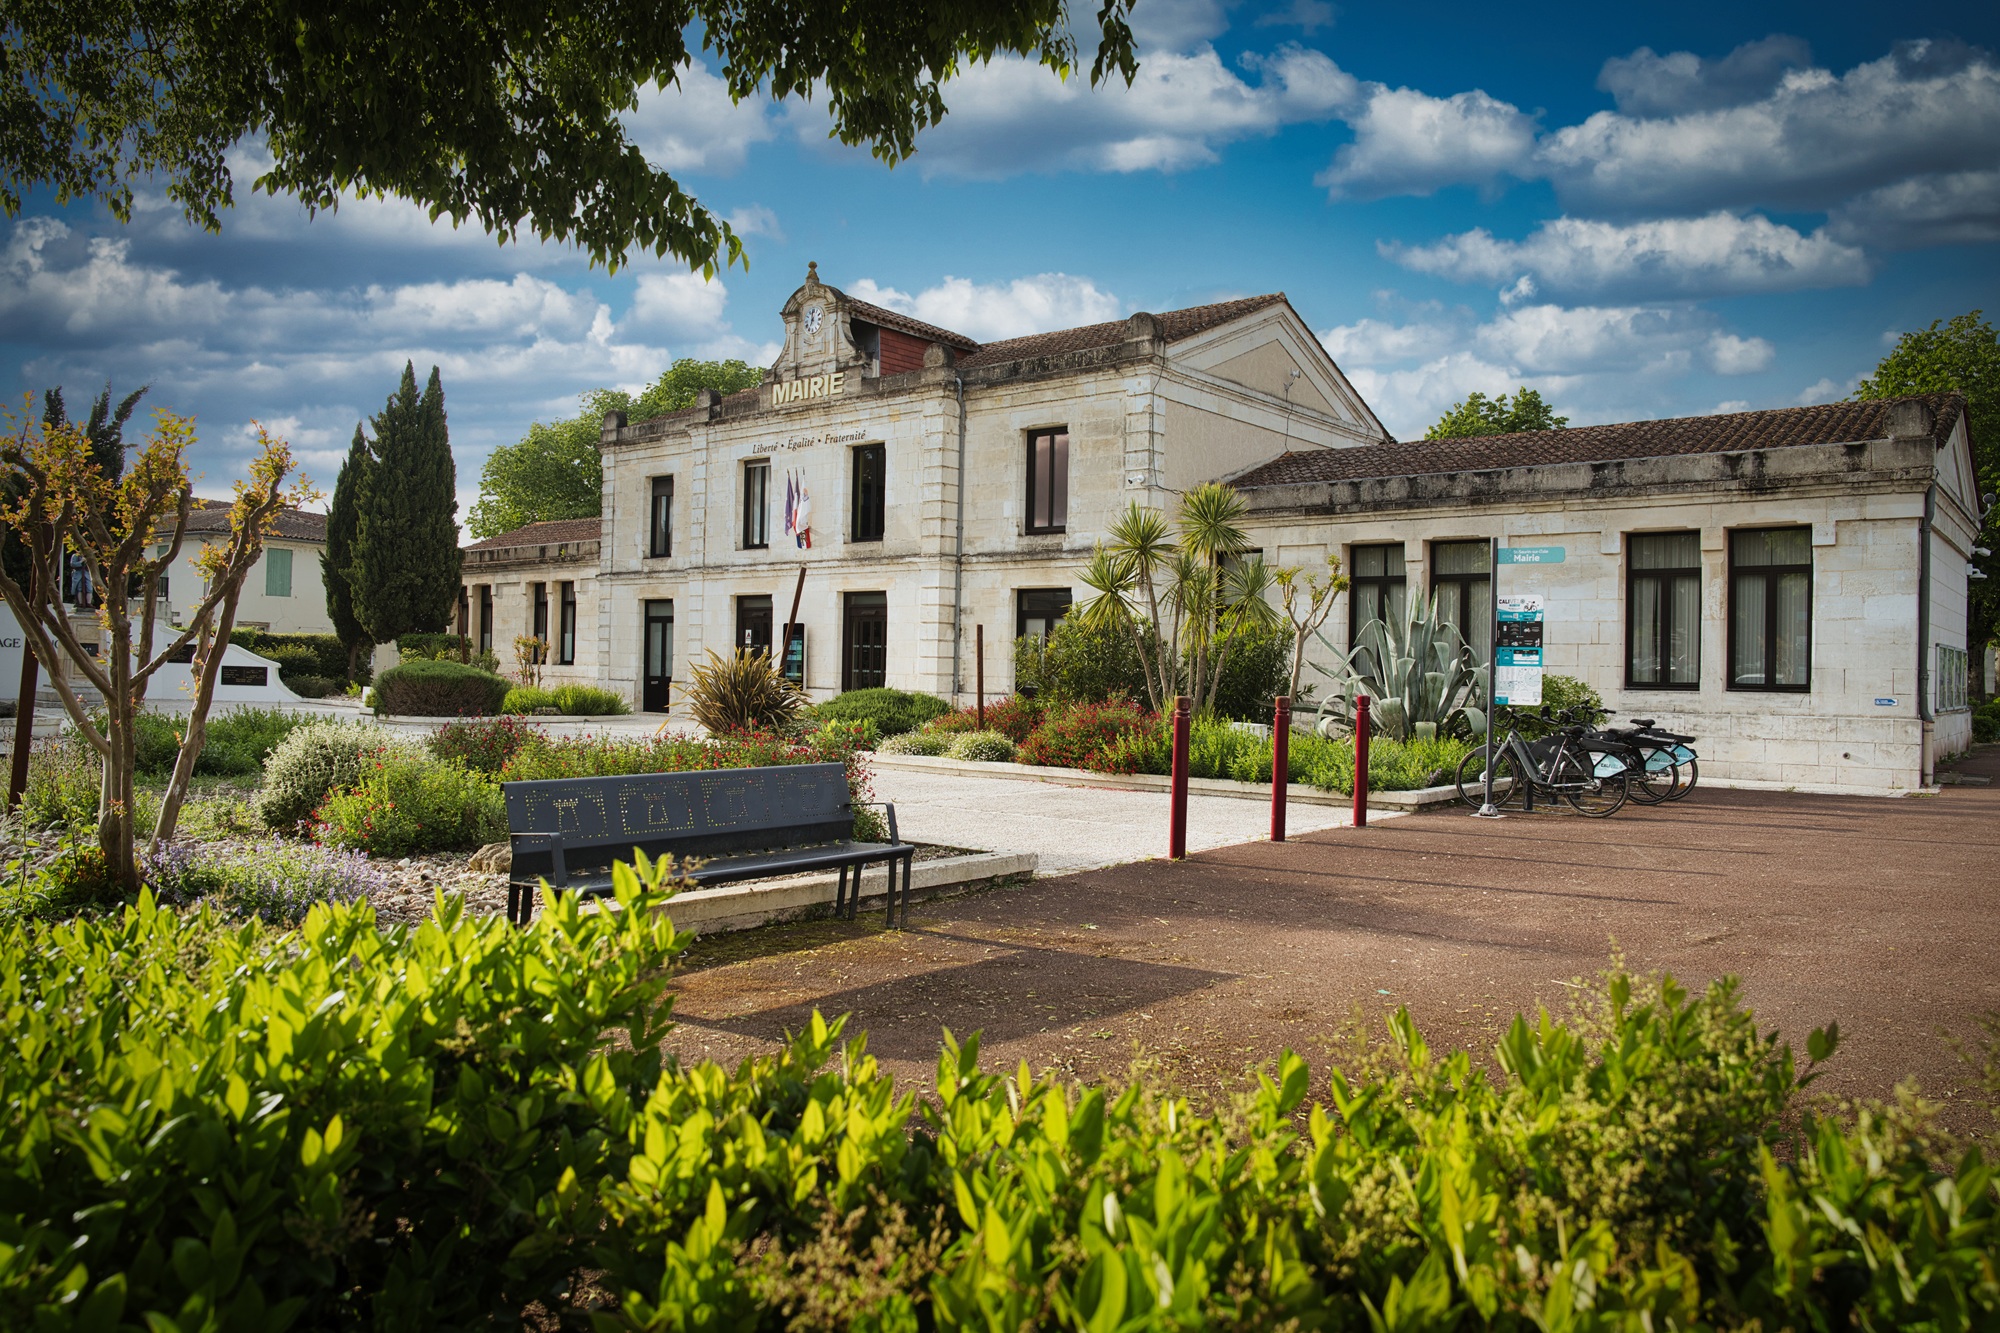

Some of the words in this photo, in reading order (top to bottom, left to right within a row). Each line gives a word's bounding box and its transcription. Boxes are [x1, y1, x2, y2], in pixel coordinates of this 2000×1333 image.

[772, 372, 844, 405] MAIRIE
[752, 443, 778, 454] Liberté
[787, 436, 815, 452] Égalité
[824, 429, 866, 445] Fraternité
[1513, 554, 1541, 562] Mairie
